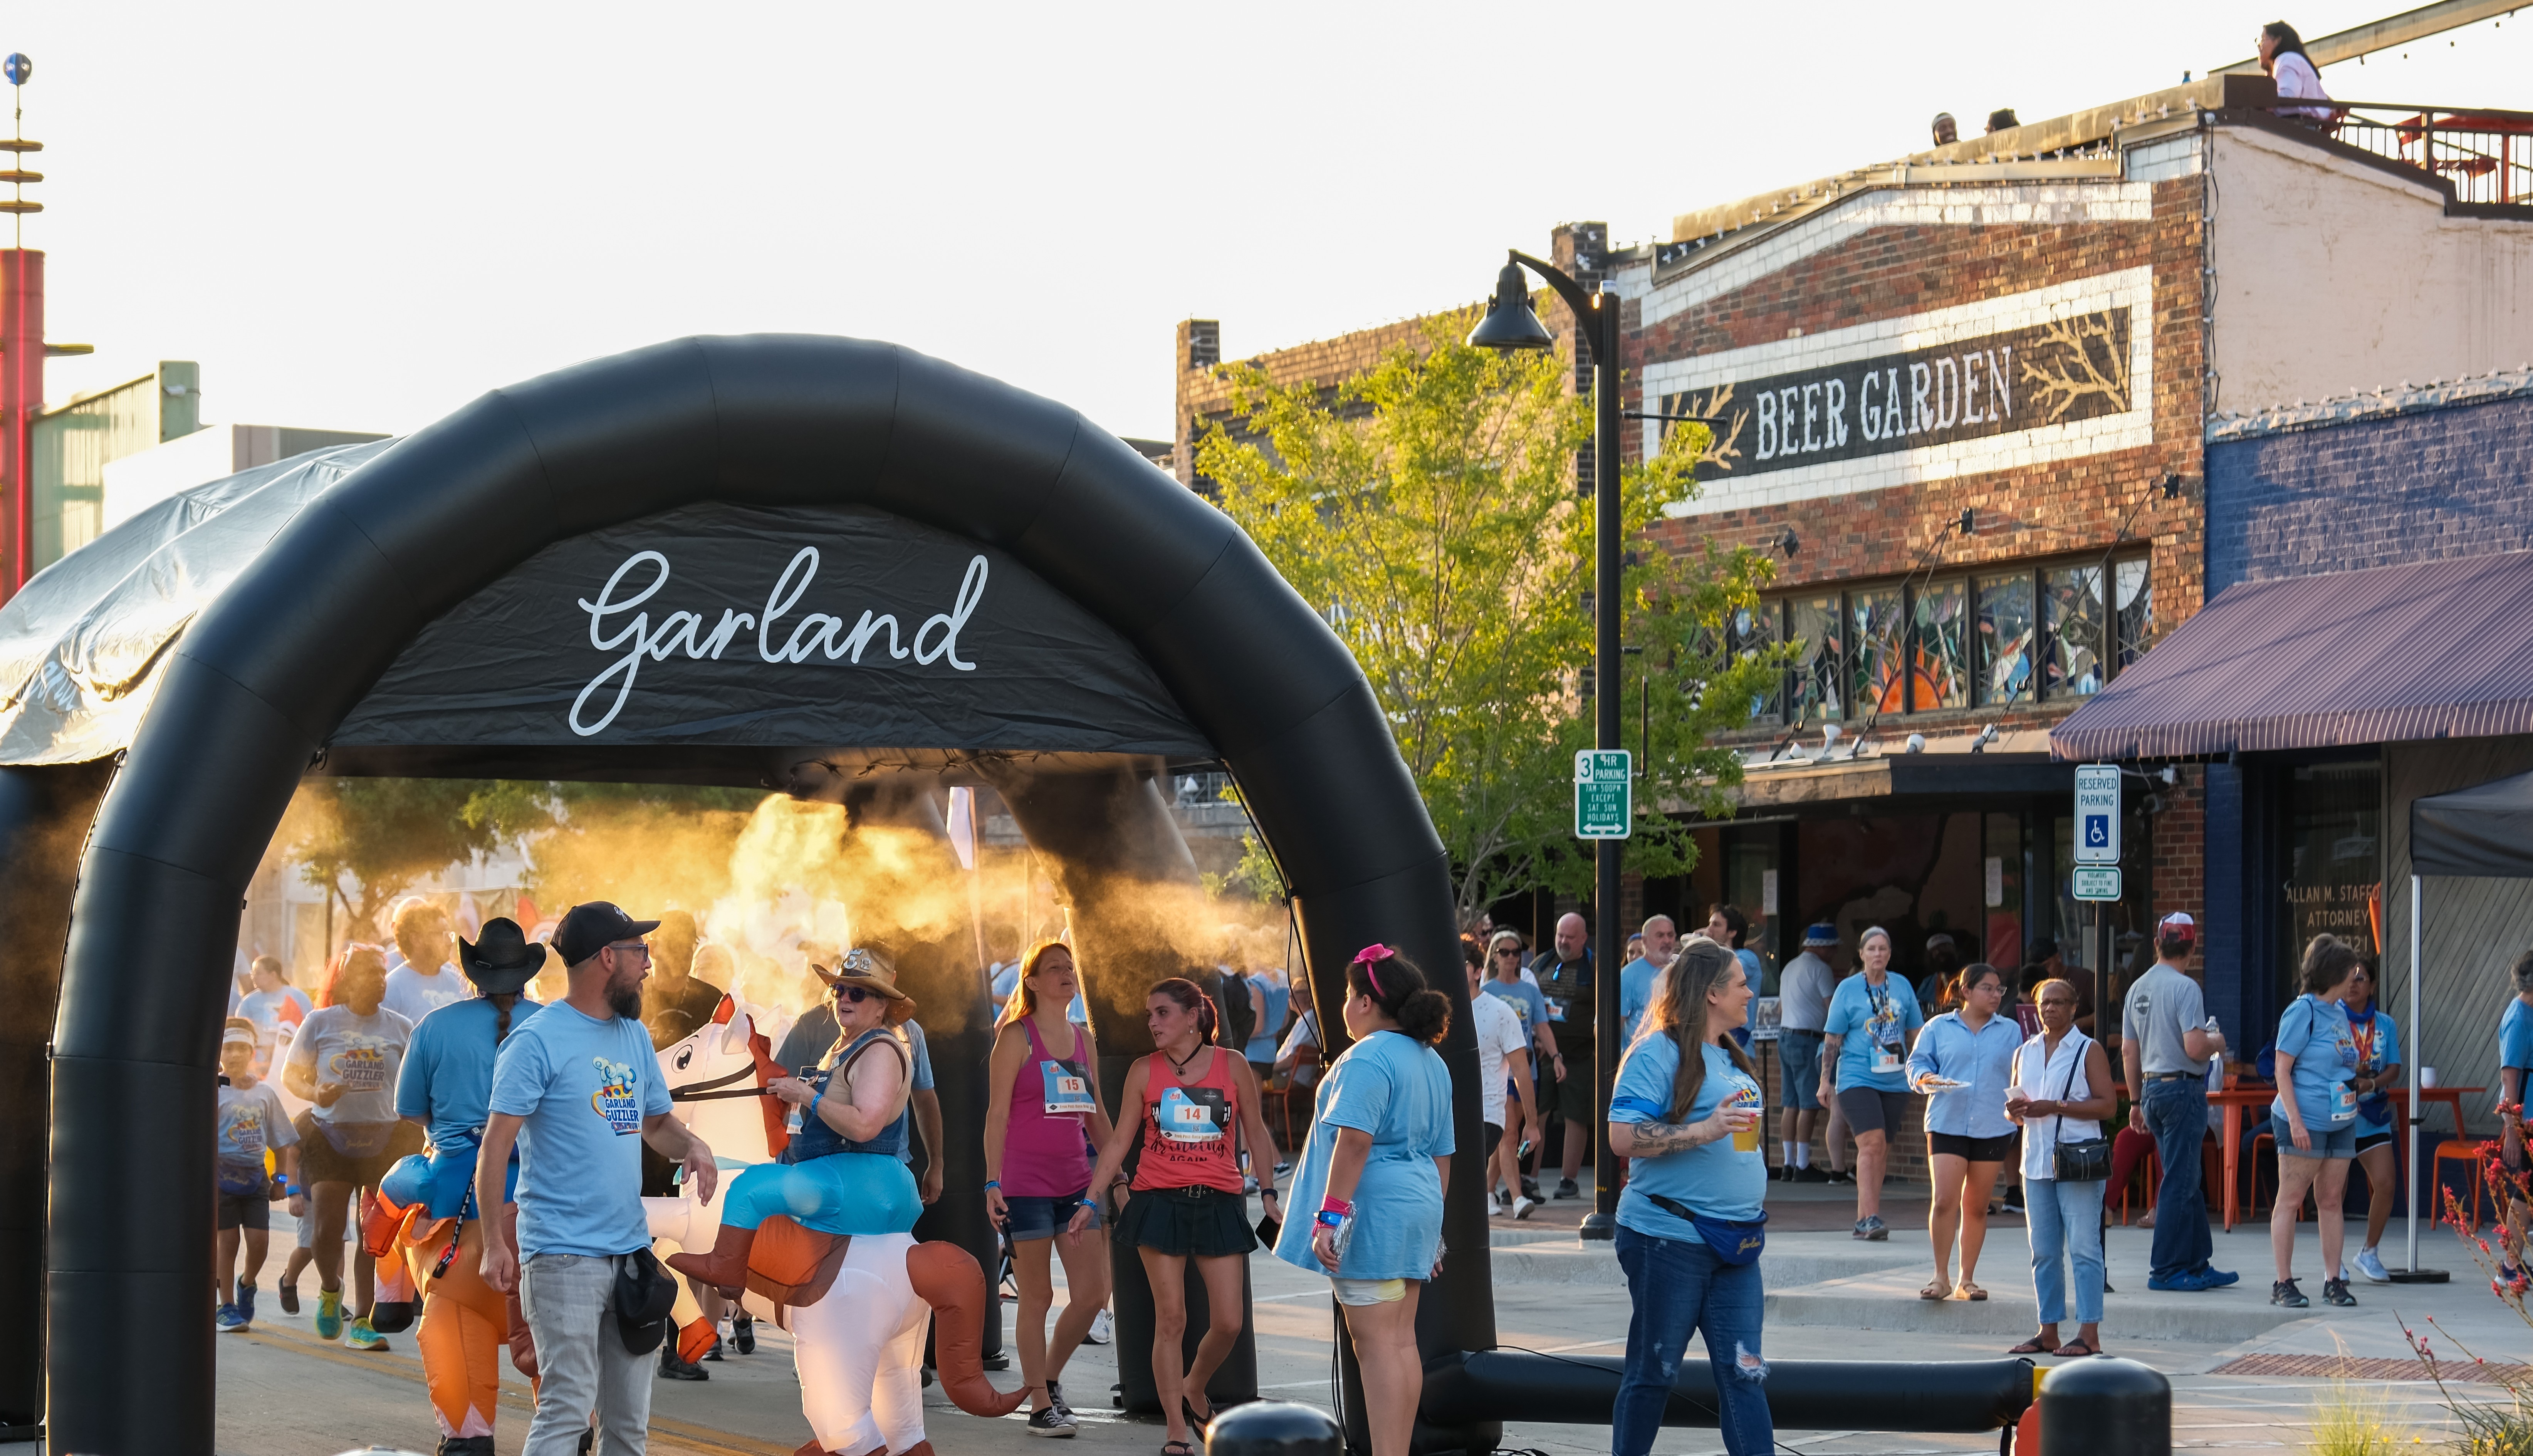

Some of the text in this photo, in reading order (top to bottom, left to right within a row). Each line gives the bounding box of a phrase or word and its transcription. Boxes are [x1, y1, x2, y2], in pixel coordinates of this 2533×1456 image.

[1755, 346, 2012, 461] BEER GARDEN
[569, 546, 989, 736] Garland
[1581, 755, 1617, 778] 3 HR
[1595, 768, 1625, 780] PARKING
[2078, 777, 2117, 790] RESERVED
[1591, 793, 1615, 803] EXCEPT
[2081, 794, 2114, 807] PARKING
[1587, 813, 1619, 822] HOLIDAYS
[2286, 886, 2320, 902] ALLAN
[2324, 886, 2335, 902] M.
[2307, 909, 2370, 928] ATTORNEY
[346, 1060, 384, 1070] GARLAND
[343, 1069, 384, 1081] GUZZLER
[1065, 1079, 1079, 1090] 15
[605, 1099, 636, 1109] GARLAND
[605, 1109, 639, 1122] GUZZLER
[1185, 1107, 1201, 1120] 14
[1150, 1136, 1225, 1159] drinking
[1737, 1237, 1761, 1254] Garla
